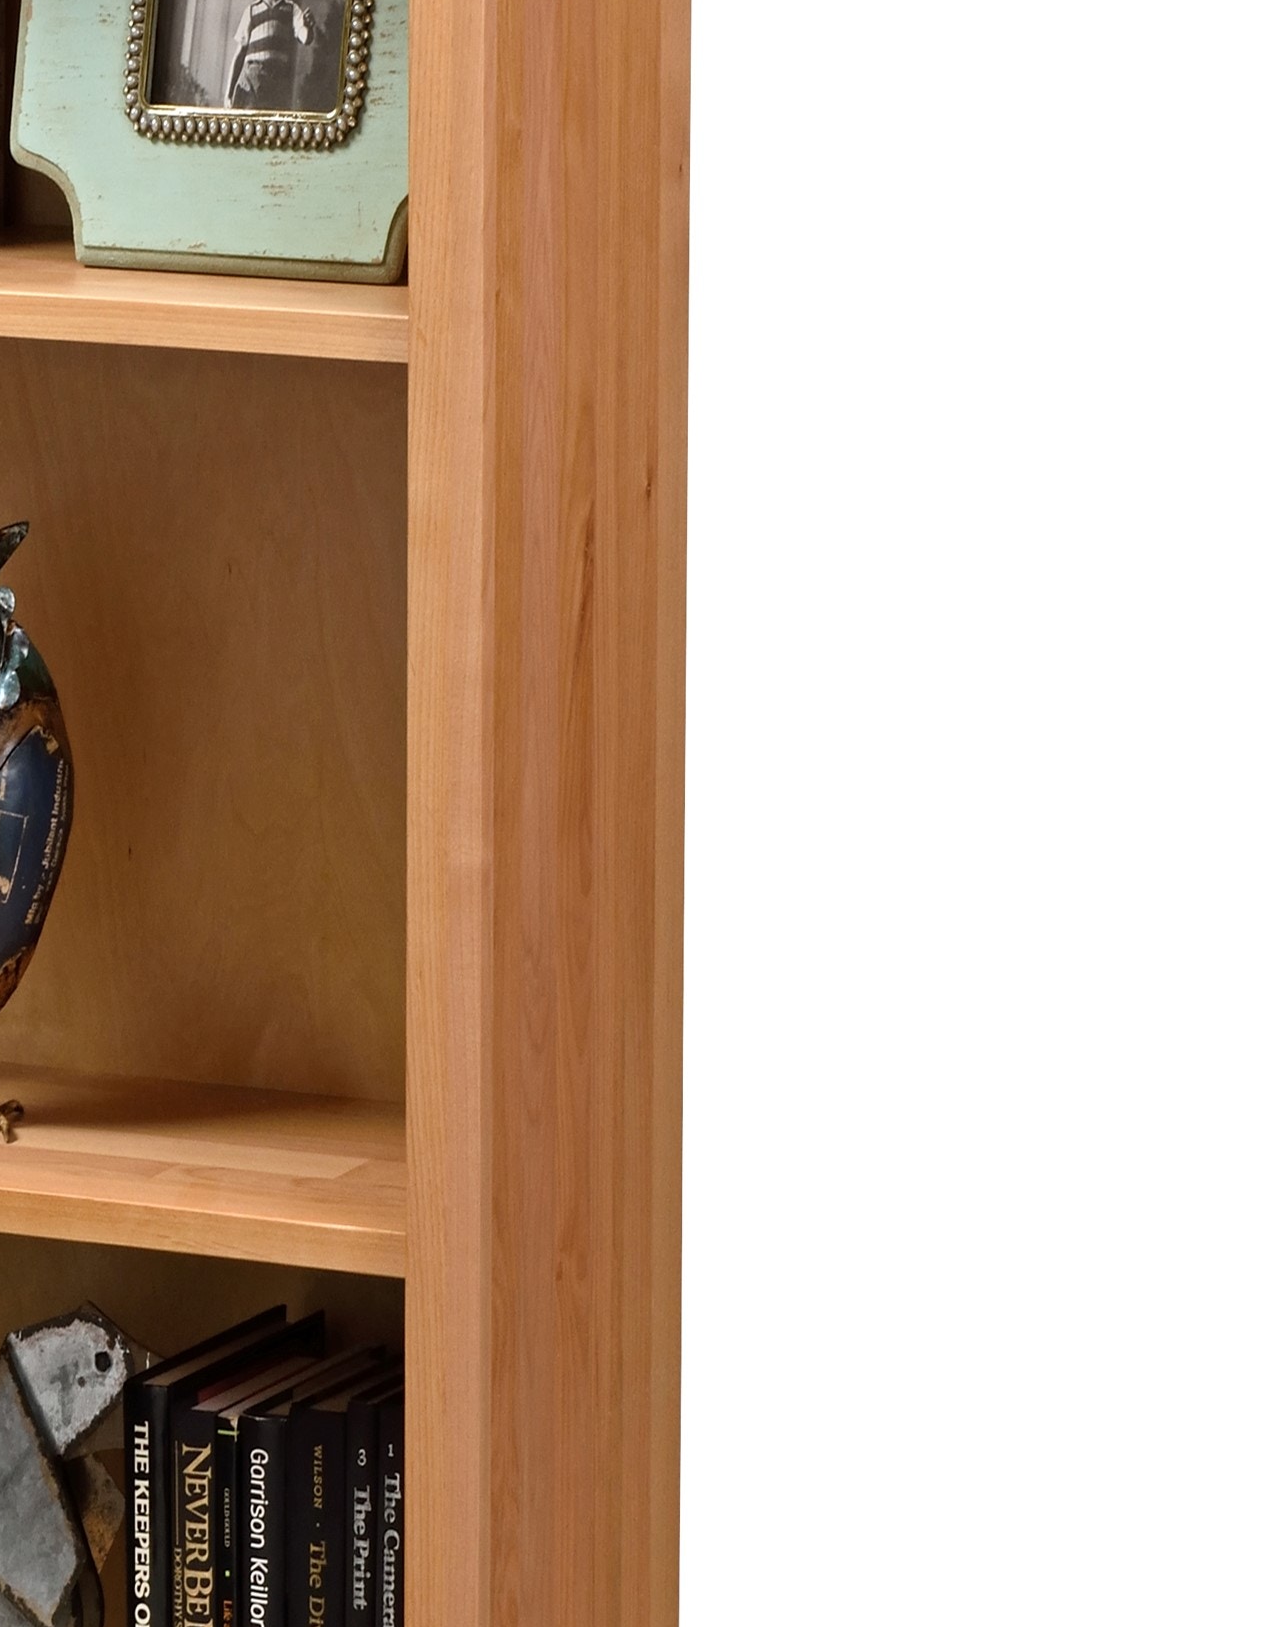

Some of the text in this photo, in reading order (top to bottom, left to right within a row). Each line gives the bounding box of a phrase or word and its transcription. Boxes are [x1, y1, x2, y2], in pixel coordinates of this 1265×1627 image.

[41, 816, 58, 870] Jubilant
[134, 1420, 149, 1474] THE
[357, 1448, 367, 1467] 3
[387, 1443, 394, 1458] 1
[181, 1442, 213, 1565] NEVER
[249, 1448, 270, 1549] Garrison
[313, 1444, 323, 1509] WILSON
[383, 1473, 402, 1524] The
[134, 1478, 150, 1599] KEEPERS
[308, 1540, 327, 1589] The
[353, 1485, 372, 1610] The Print
[173, 1547, 183, 1620] DOROTHY
[183, 1567, 214, 1616] BE
[223, 1599, 233, 1621] Life
